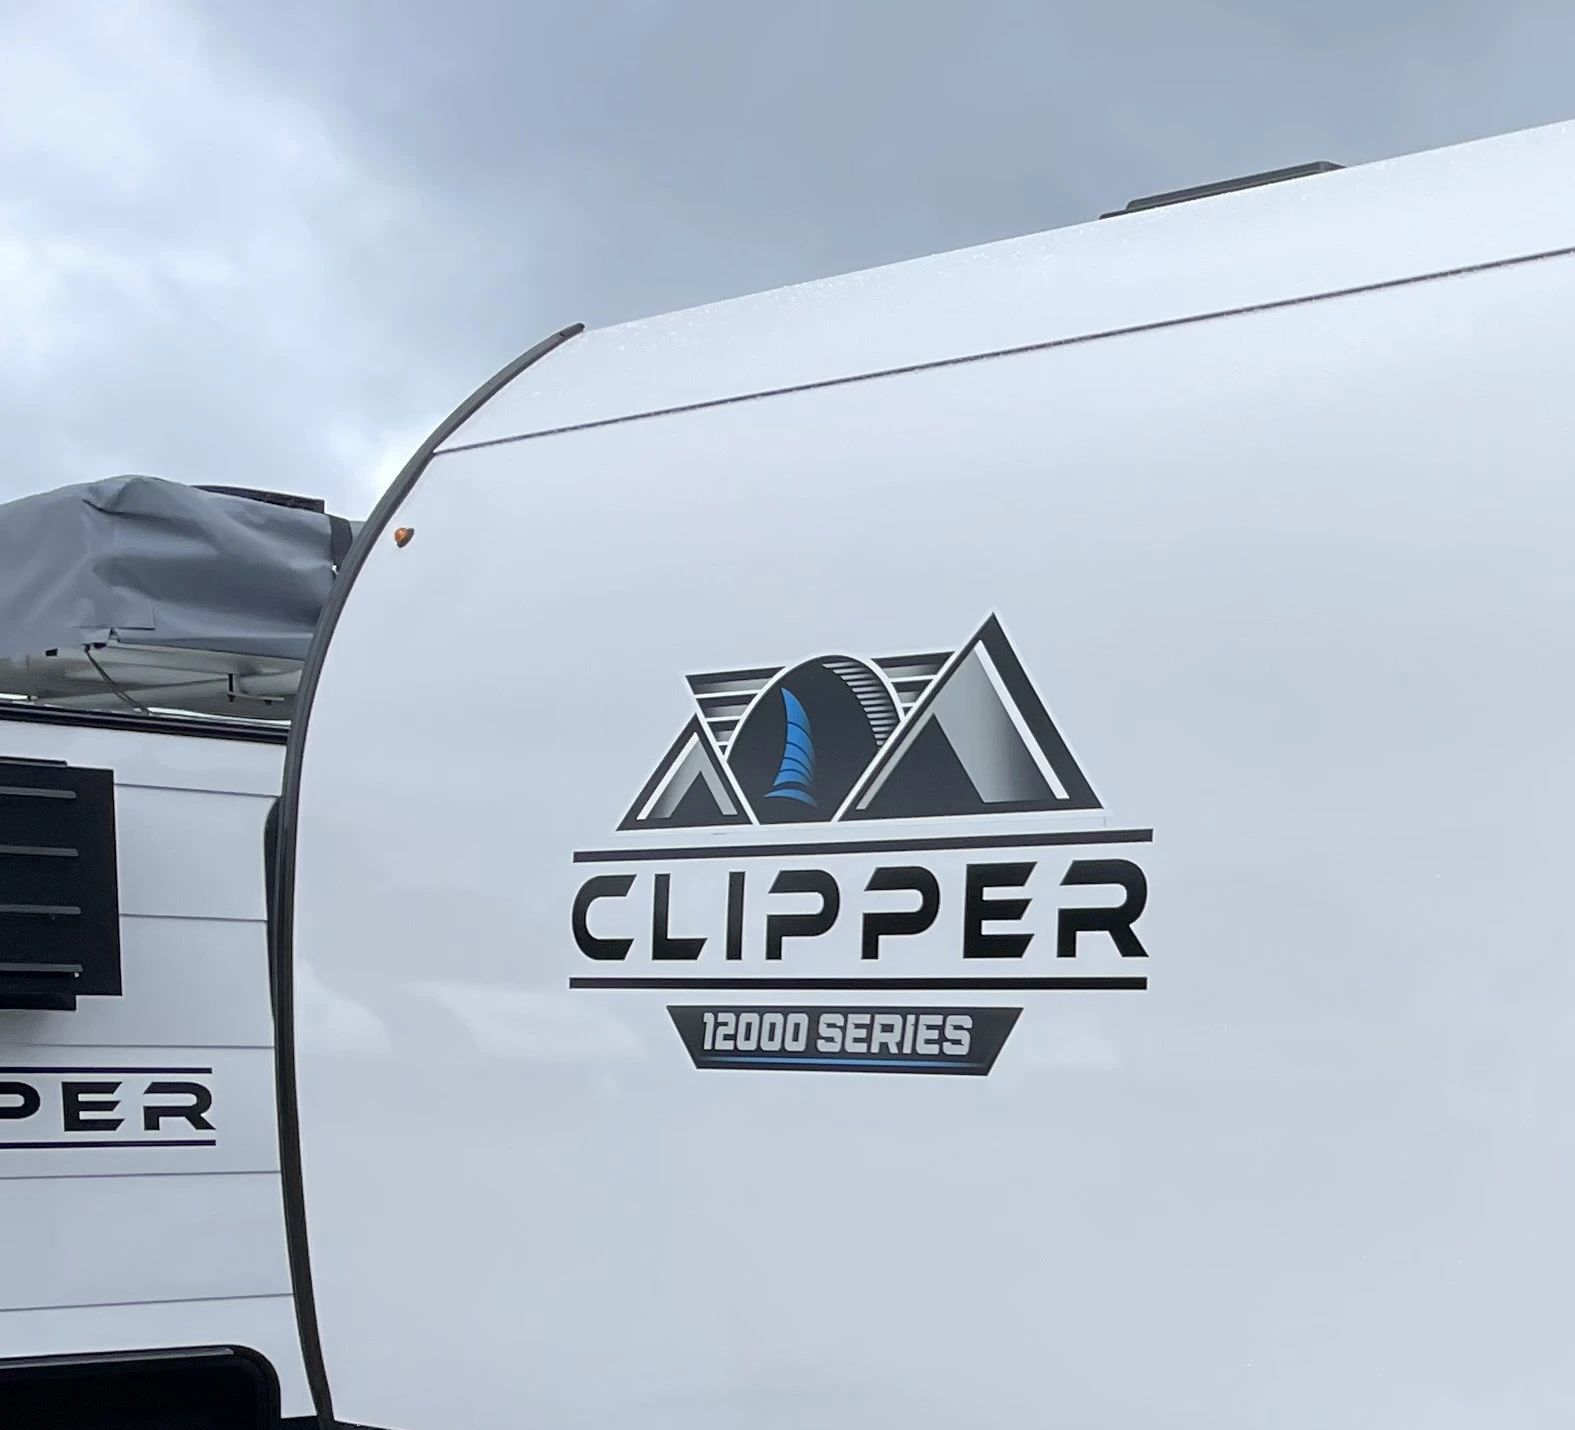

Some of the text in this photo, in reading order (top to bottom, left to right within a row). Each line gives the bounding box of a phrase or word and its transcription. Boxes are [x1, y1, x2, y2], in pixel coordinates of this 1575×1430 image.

[571, 859, 1150, 961] CLIPPER
[701, 1011, 973, 1057] 12000 SERIES
